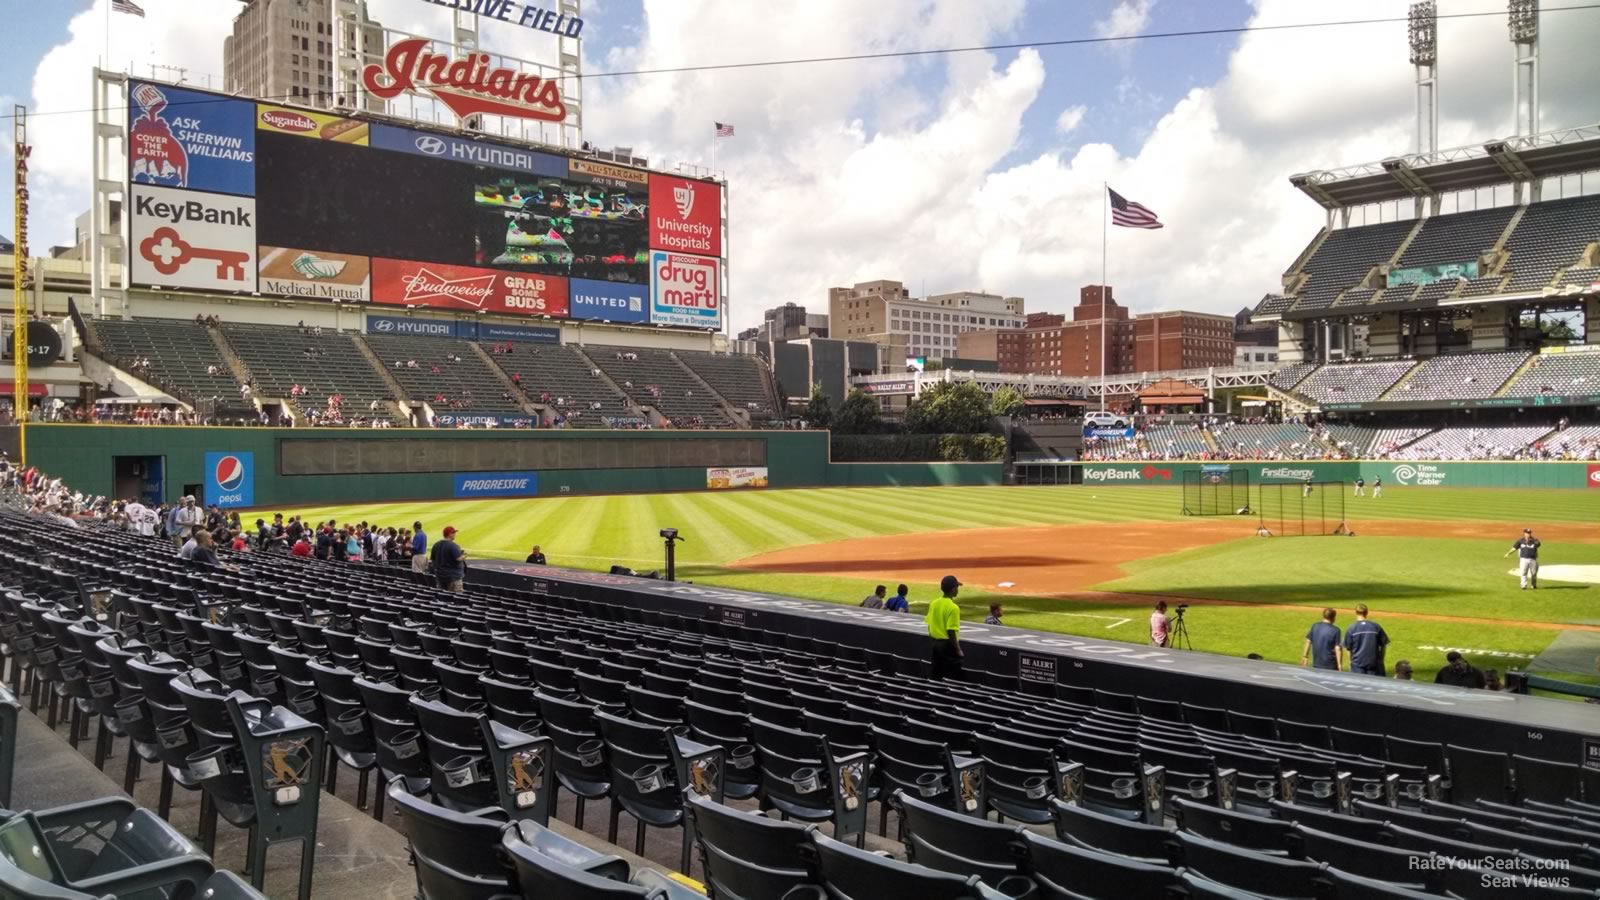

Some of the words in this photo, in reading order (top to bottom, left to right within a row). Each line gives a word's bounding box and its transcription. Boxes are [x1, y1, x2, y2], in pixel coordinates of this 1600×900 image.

[519, 5, 584, 39] FIELD
[363, 38, 566, 120] Indians
[172, 117, 201, 130] ASK
[262, 111, 316, 131] Sugardale
[136, 134, 168, 144] COVER
[143, 141, 162, 150] THE
[178, 130, 242, 149] SHERWIN
[137, 148, 168, 158] EARTH
[187, 143, 254, 163] WILLIAMS
[452, 143, 532, 170] HYUNDAI
[624, 171, 644, 181] GAME
[675, 191, 685, 200] UH
[16, 143, 32, 273] WALGREENS
[135, 195, 251, 228] KeyBank
[657, 217, 712, 239] University
[659, 233, 711, 250] Hospitals
[672, 256, 699, 264] DISCOUNT
[659, 256, 707, 291] drug
[266, 280, 317, 297] Medical
[320, 285, 364, 299] Mutual
[401, 275, 494, 298] Budweiser
[504, 276, 546, 291] GRAB
[511, 289, 539, 298] SOME
[664, 289, 718, 309] mart
[505, 296, 546, 309] BUDS
[575, 294, 626, 308] UNITED
[652, 314, 668, 322] More
[669, 315, 683, 323] than
[690, 317, 719, 326] Drugstore
[397, 321, 449, 334] HYUNDAI
[1084, 468, 1140, 481] KeyBank
[1261, 468, 1314, 478] FirstEnergy
[1417, 464, 1437, 472] Time
[1417, 471, 1446, 479] Warner
[462, 478, 529, 491] PROGRESSIVE
[219, 493, 242, 505] pepsi
[1022, 657, 1031, 665] BE
[1032, 659, 1054, 669] ALERT
[1527, 731, 1543, 740] 160
[1590, 746, 1600, 757] B
